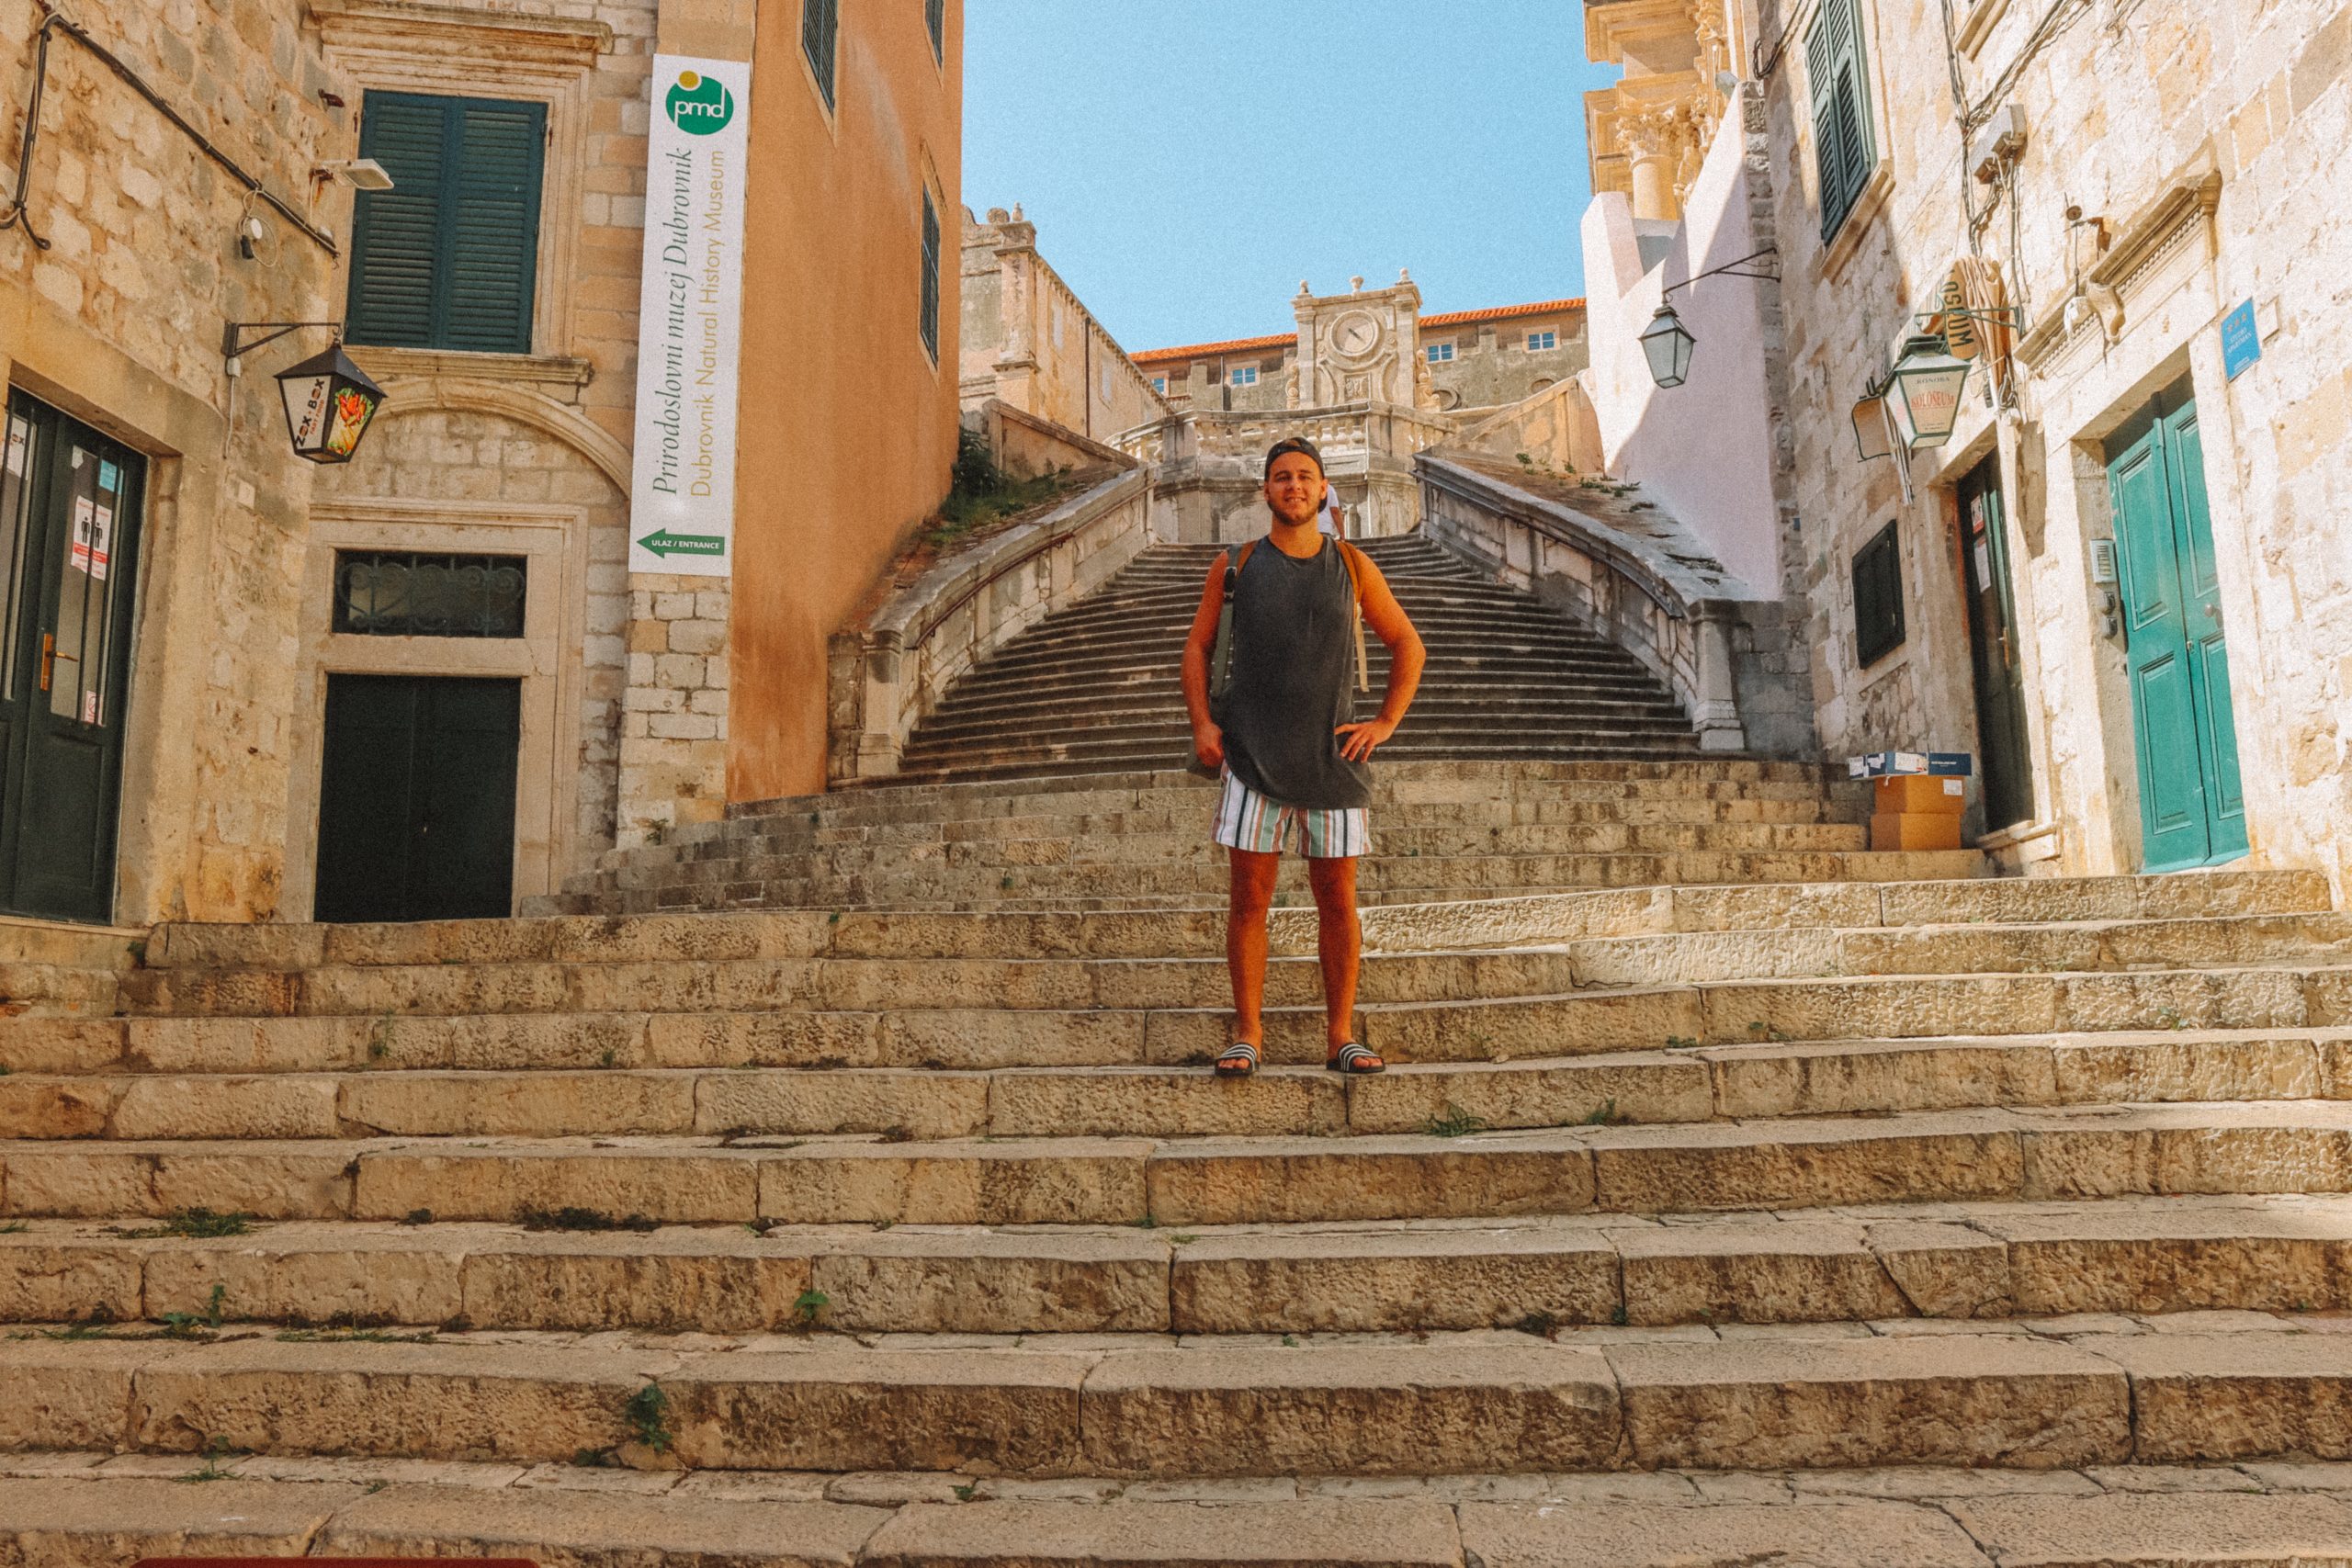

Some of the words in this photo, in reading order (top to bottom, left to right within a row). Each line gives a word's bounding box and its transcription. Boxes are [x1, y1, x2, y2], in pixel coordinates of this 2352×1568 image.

[674, 83, 725, 127] pmd
[662, 147, 692, 265] Dubrovnik
[703, 151, 724, 231] Museum
[665, 271, 695, 338] muzej
[699, 238, 725, 304] History
[695, 312, 718, 386] Natural
[653, 343, 683, 495] Prirodoslovni
[1910, 390, 1955, 408] KOLOSEUM
[691, 394, 715, 497] Dubrovnik
[678, 541, 720, 549] ENTRANCE
